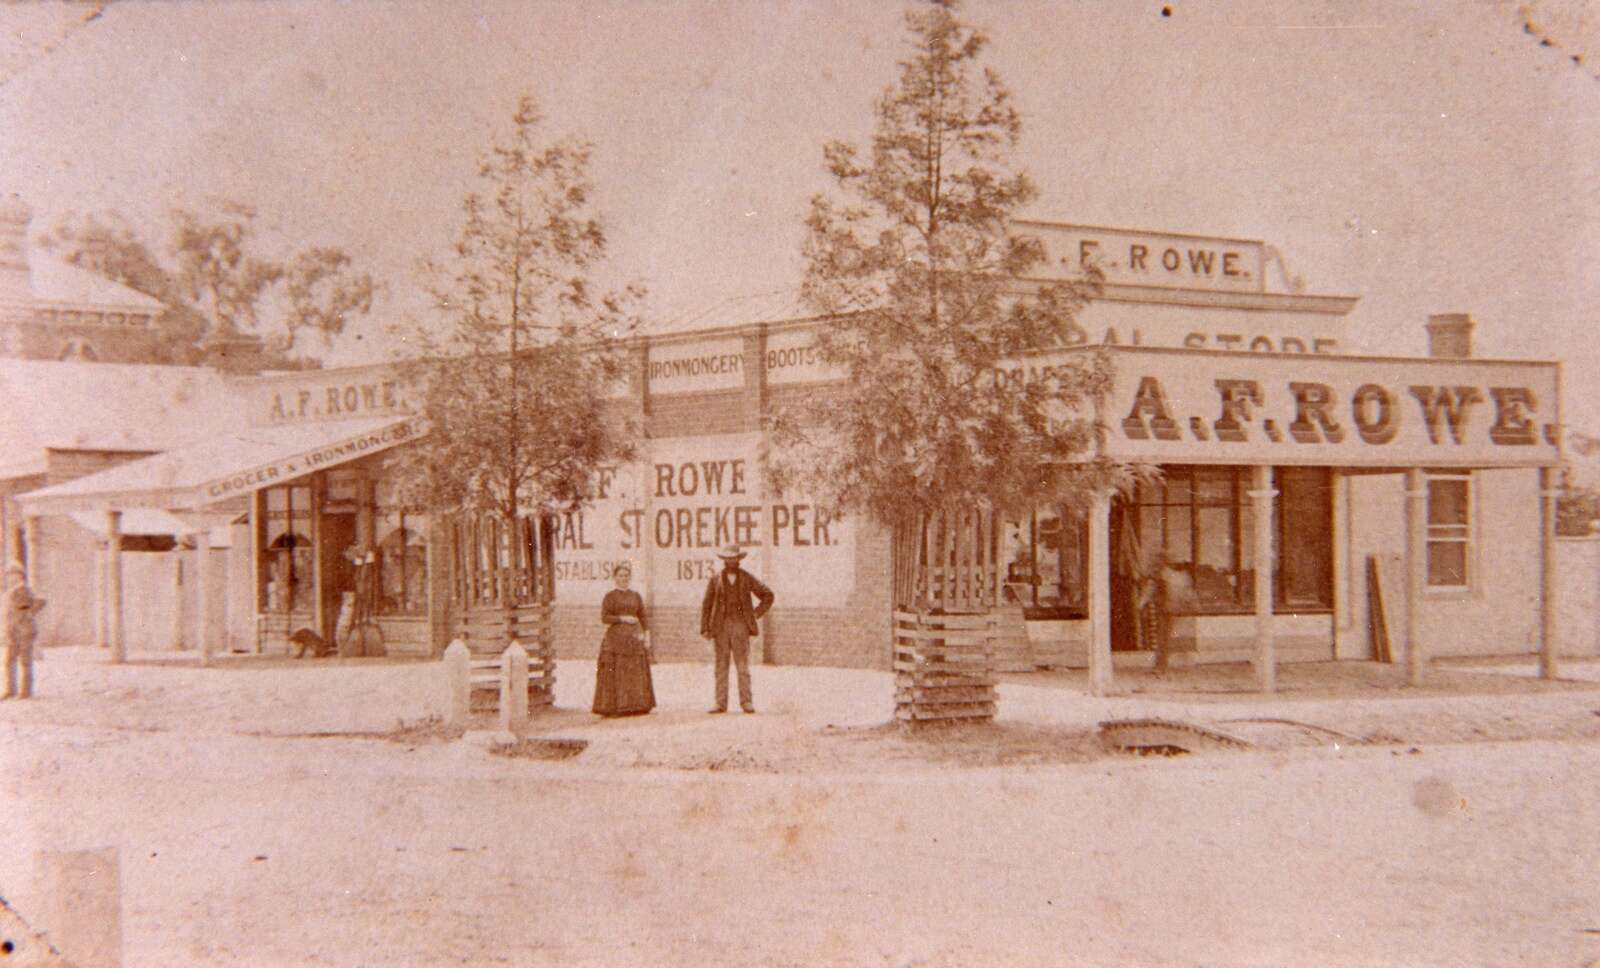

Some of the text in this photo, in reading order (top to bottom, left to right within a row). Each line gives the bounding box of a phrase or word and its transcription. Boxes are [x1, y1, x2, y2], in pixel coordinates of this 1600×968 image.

[208, 465, 279, 497] GROCER
[654, 459, 746, 497] ROWE
[677, 559, 715, 580] 1873
